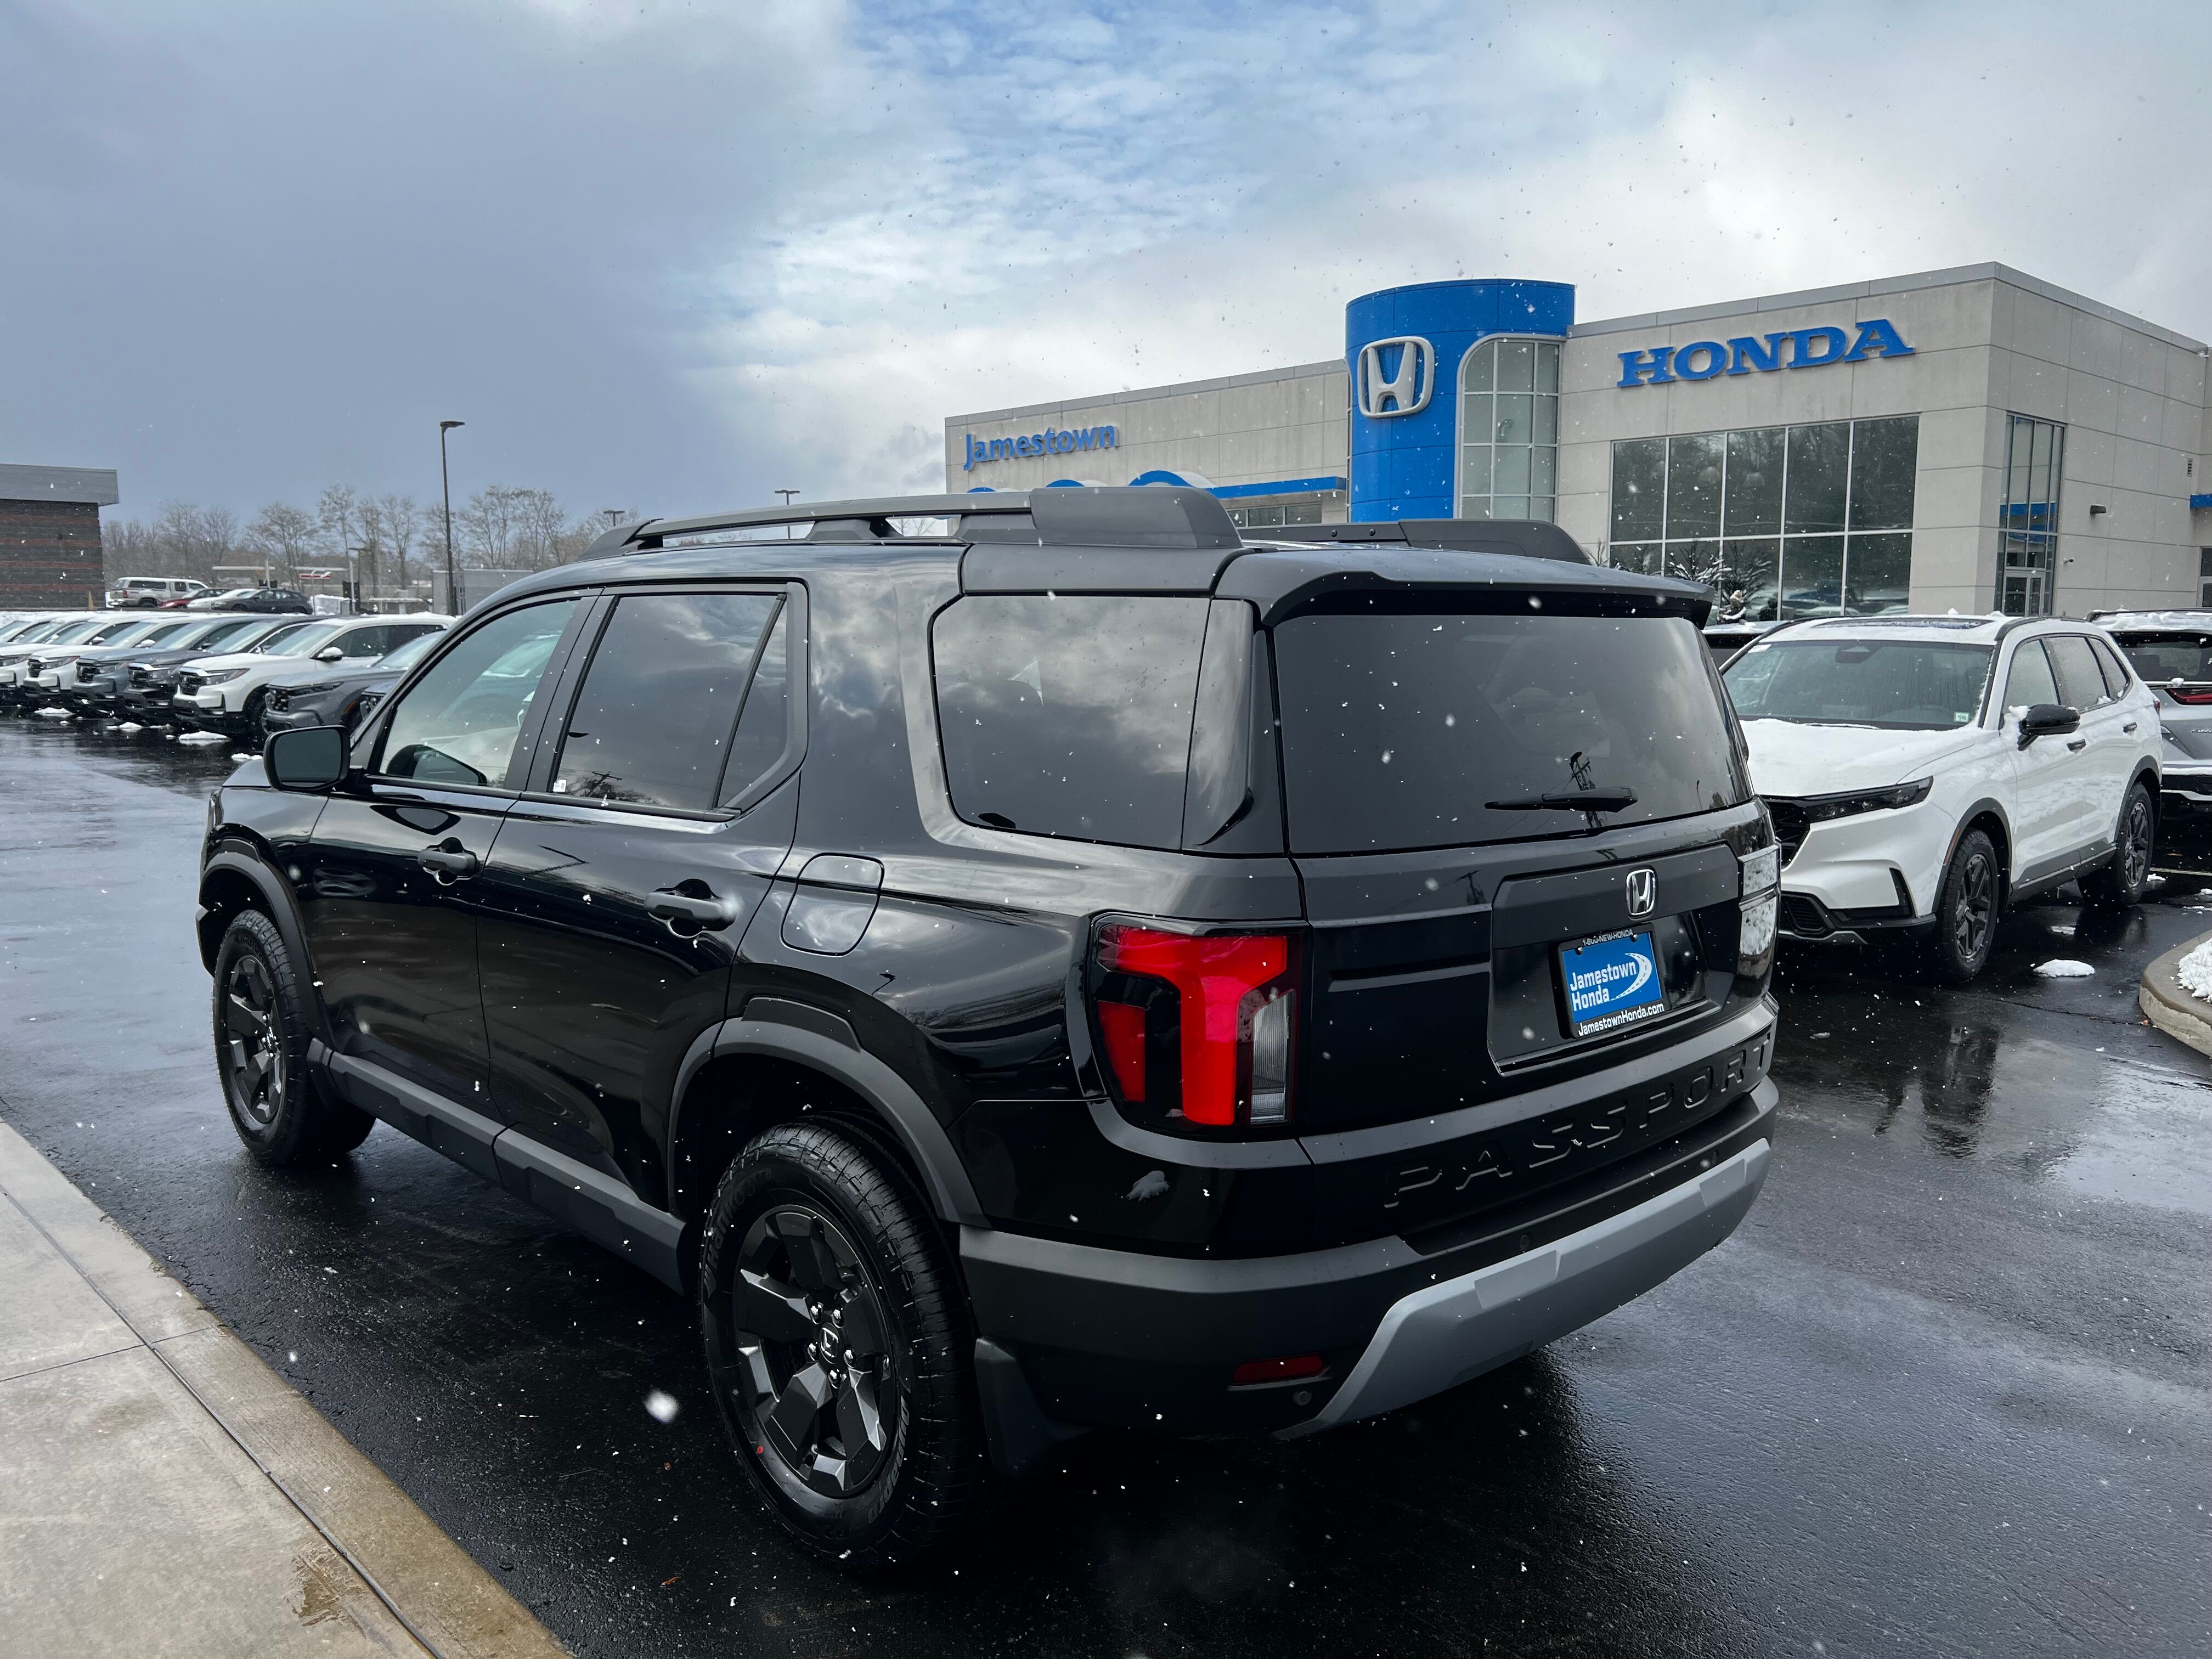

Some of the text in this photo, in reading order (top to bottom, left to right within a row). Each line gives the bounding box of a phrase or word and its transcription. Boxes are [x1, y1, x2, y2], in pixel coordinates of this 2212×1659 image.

[1616, 319, 1915, 387] HONDA
[963, 425, 1116, 471] Jamestown
[1570, 961, 1637, 991] Jamestown
[1571, 985, 1610, 1012] Honda
[1578, 1003, 1664, 1036] JamestownHonda.com
[1383, 1033, 1771, 1208] PASSPORT
